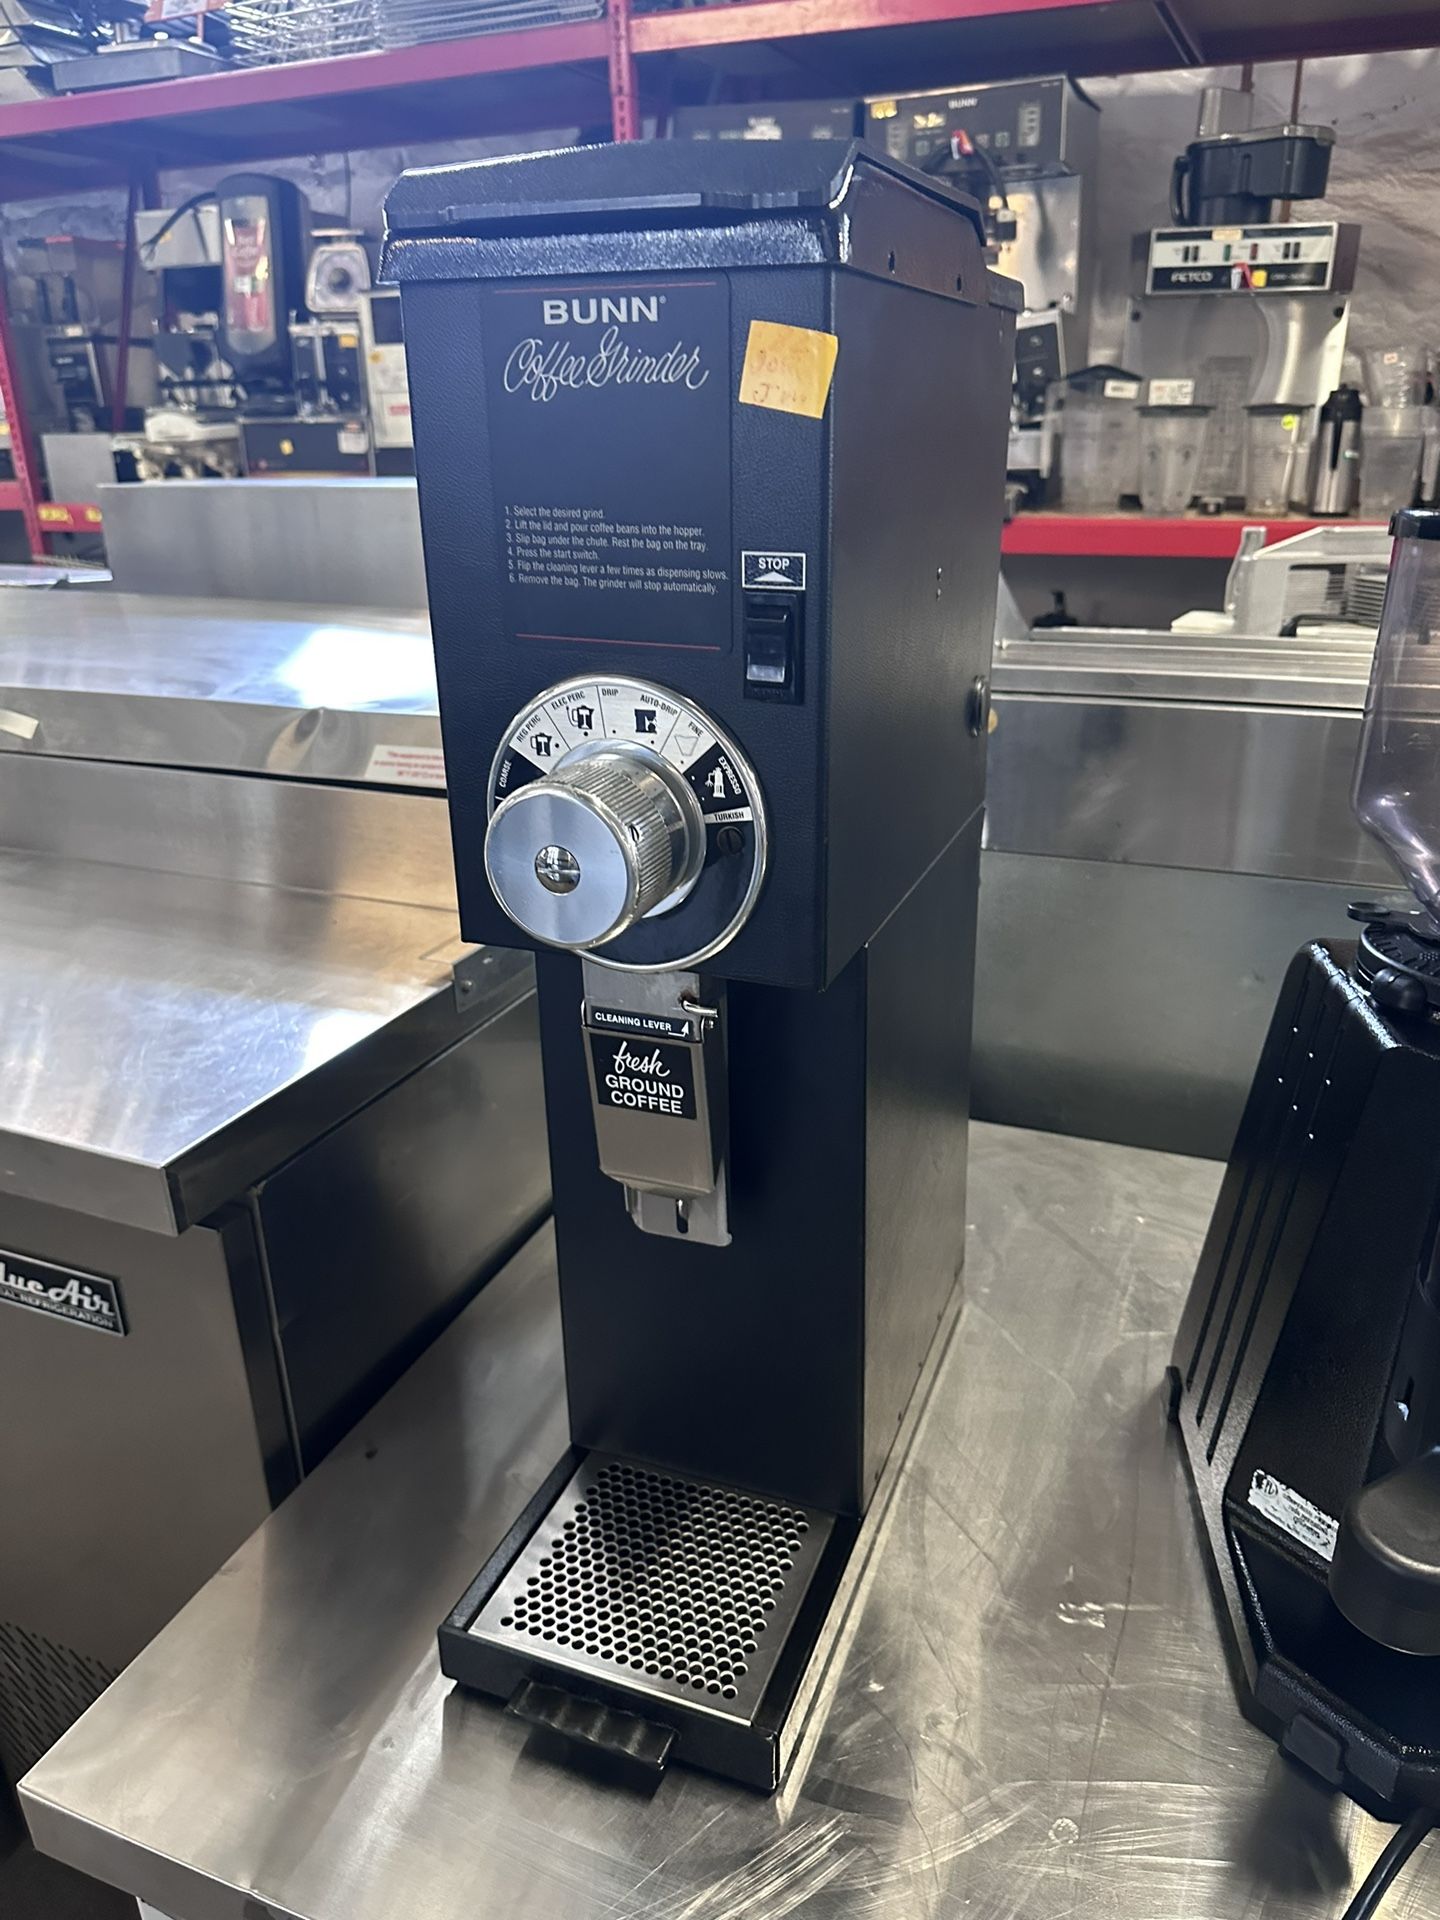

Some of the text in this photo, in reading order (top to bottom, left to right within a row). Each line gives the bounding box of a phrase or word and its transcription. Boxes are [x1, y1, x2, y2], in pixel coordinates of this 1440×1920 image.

[504, 325, 709, 401] Coffee Grinder
[513, 505, 537, 516] Select
[539, 506, 551, 517] the
[552, 507, 581, 518] desired
[514, 520, 528, 530] Lift
[529, 521, 541, 531] the
[543, 521, 553, 531] lid
[554, 522, 569, 532] and
[570, 523, 588, 533] pour
[590, 522, 614, 533] coffee
[616, 523, 640, 534] beans
[641, 524, 657, 535] into
[659, 525, 672, 536] the
[673, 525, 704, 538] hopper.
[515, 533, 531, 545] Slip
[532, 534, 547, 546] bag
[548, 535, 570, 545] under
[571, 535, 584, 546] the
[586, 536, 608, 547] chute.
[611, 537, 630, 548] Rest
[631, 538, 644, 548] the
[646, 538, 661, 551] bag
[663, 540, 674, 550] on
[675, 539, 688, 550] the
[690, 540, 709, 553] tray.
[516, 546, 538, 557] Press
[539, 548, 552, 558] the
[553, 549, 571, 559] start
[573, 549, 599, 560] switch.
[517, 560, 531, 572] Flip
[532, 561, 545, 571] the
[546, 562, 578, 575] cleaning
[580, 563, 599, 574] lever
[607, 564, 621, 575] few
[622, 565, 644, 577] times
[646, 567, 656, 577] as
[657, 566, 700, 580] dispensing
[702, 569, 728, 580] slows.
[758, 557, 790, 570] STOP
[518, 573, 549, 585] Remove
[550, 575, 563, 585] the
[564, 576, 581, 588] bag.
[582, 576, 598, 587] The
[599, 578, 626, 590] grinder
[628, 580, 642, 590] will
[643, 580, 662, 592] stop
[663, 581, 719, 595] automatically.
[551, 691, 586, 711] ELEC PERC
[601, 688, 619, 697] DRIP
[640, 694, 678, 716] AUTO-DRIP
[516, 714, 541, 744] REG PERC
[688, 721, 704, 738] FINE
[499, 759, 512, 788] COARSE
[717, 756, 742, 795] EXPRESSO
[714, 811, 745, 821] TURKISH
[595, 1012, 672, 1032] CLEANING LEVER
[612, 1040, 671, 1077] fresh
[605, 1074, 684, 1099] GROUND
[611, 1090, 683, 1115] COFFEE
[20, 1293, 114, 1328] REFRIGERATION
